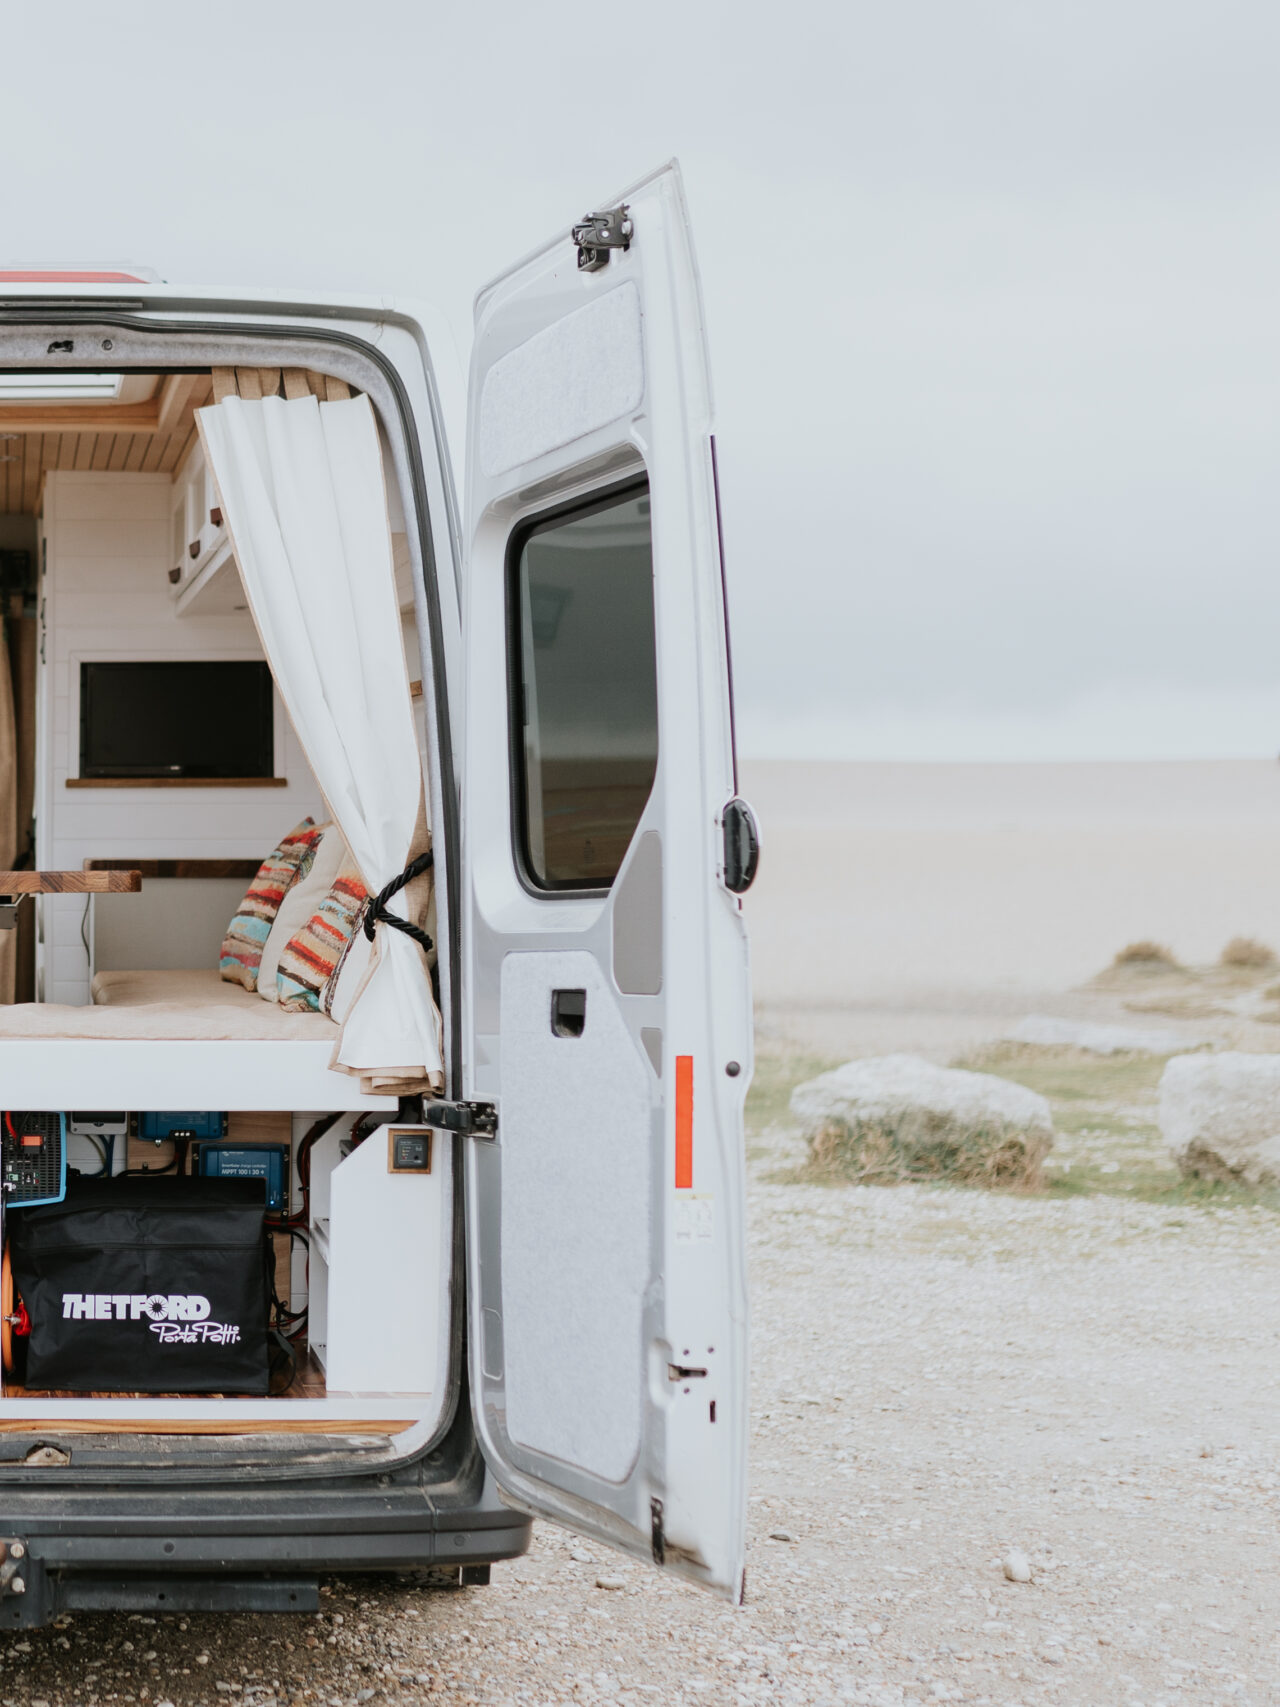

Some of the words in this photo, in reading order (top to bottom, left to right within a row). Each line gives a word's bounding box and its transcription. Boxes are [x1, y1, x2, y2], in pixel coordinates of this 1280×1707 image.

[62, 1294, 211, 1321] THETFORD
[149, 1322, 198, 1343] Porta
[192, 1322, 240, 1345] Potti
